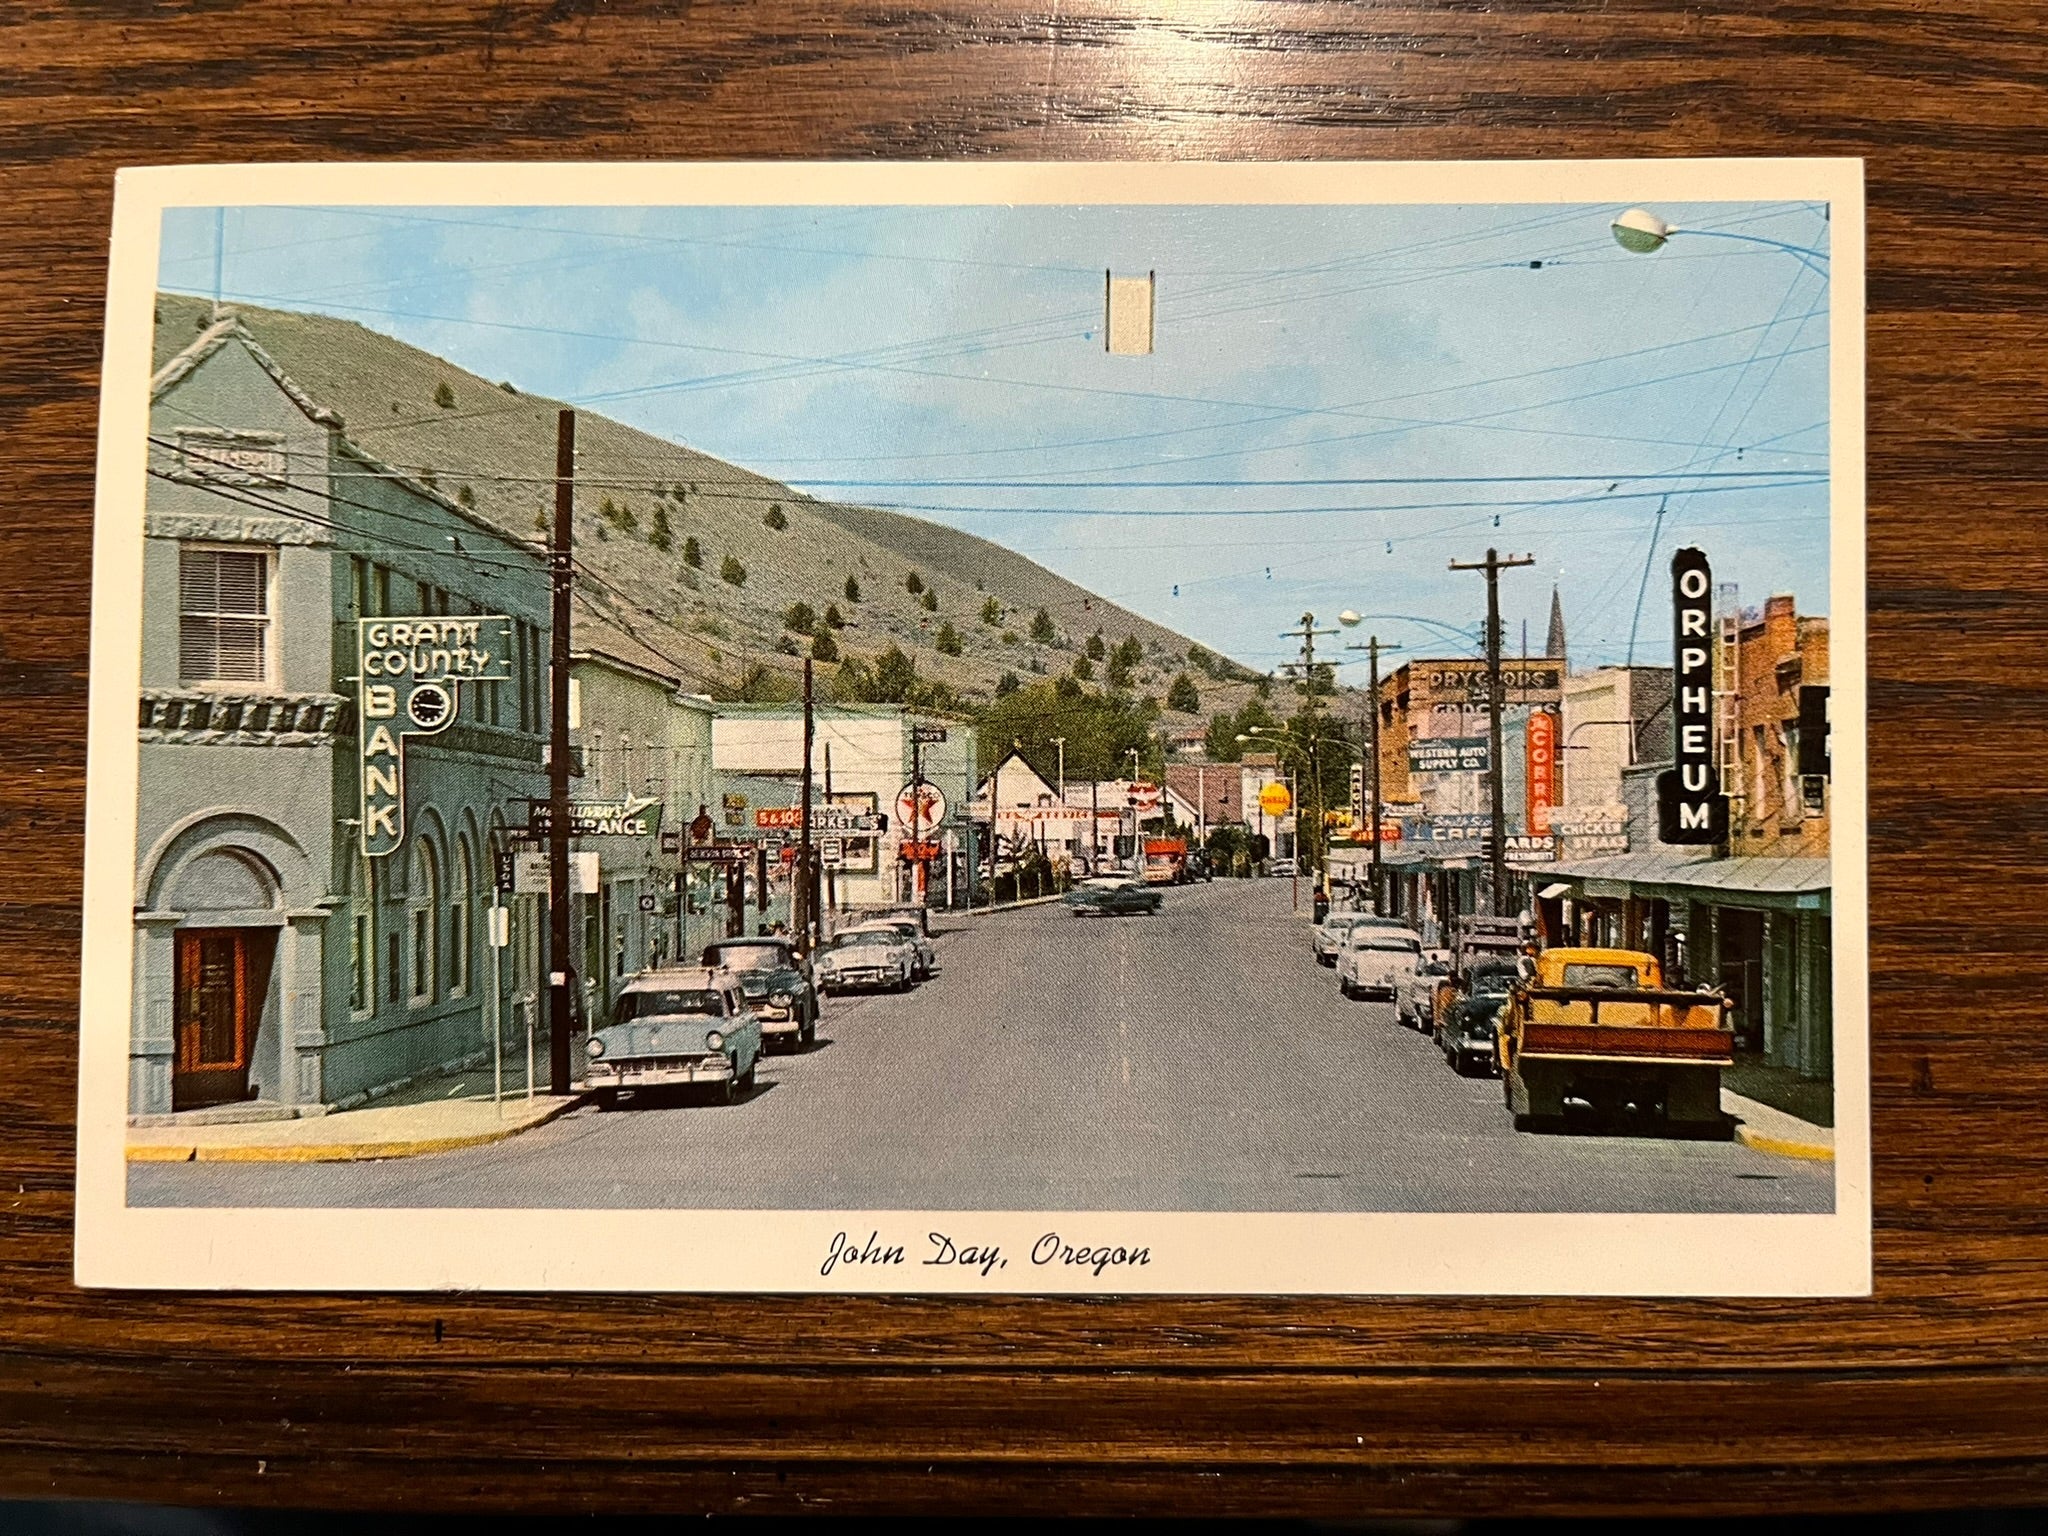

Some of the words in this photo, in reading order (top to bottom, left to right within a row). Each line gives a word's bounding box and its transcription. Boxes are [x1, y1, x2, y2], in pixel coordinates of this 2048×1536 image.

[364, 650, 489, 675] COUNTY
[1474, 671, 1547, 688] GODS
[1679, 569, 1709, 831] ORPHEUM
[1410, 748, 1457, 758] WESTERN
[1460, 742, 1487, 757] AUTO
[365, 684, 398, 837] BANK
[1419, 759, 1458, 769] SUPPLY
[759, 811, 768, 824] 5
[538, 819, 648, 835] INURANCE
[1432, 828, 1493, 840] CAFE
[1561, 823, 1621, 834] CHICKEN
[1503, 836, 1554, 849] ARDS
[820, 1231, 905, 1277] John
[922, 1232, 1008, 1277] Day,
[1031, 1232, 1151, 1277] Oregon
